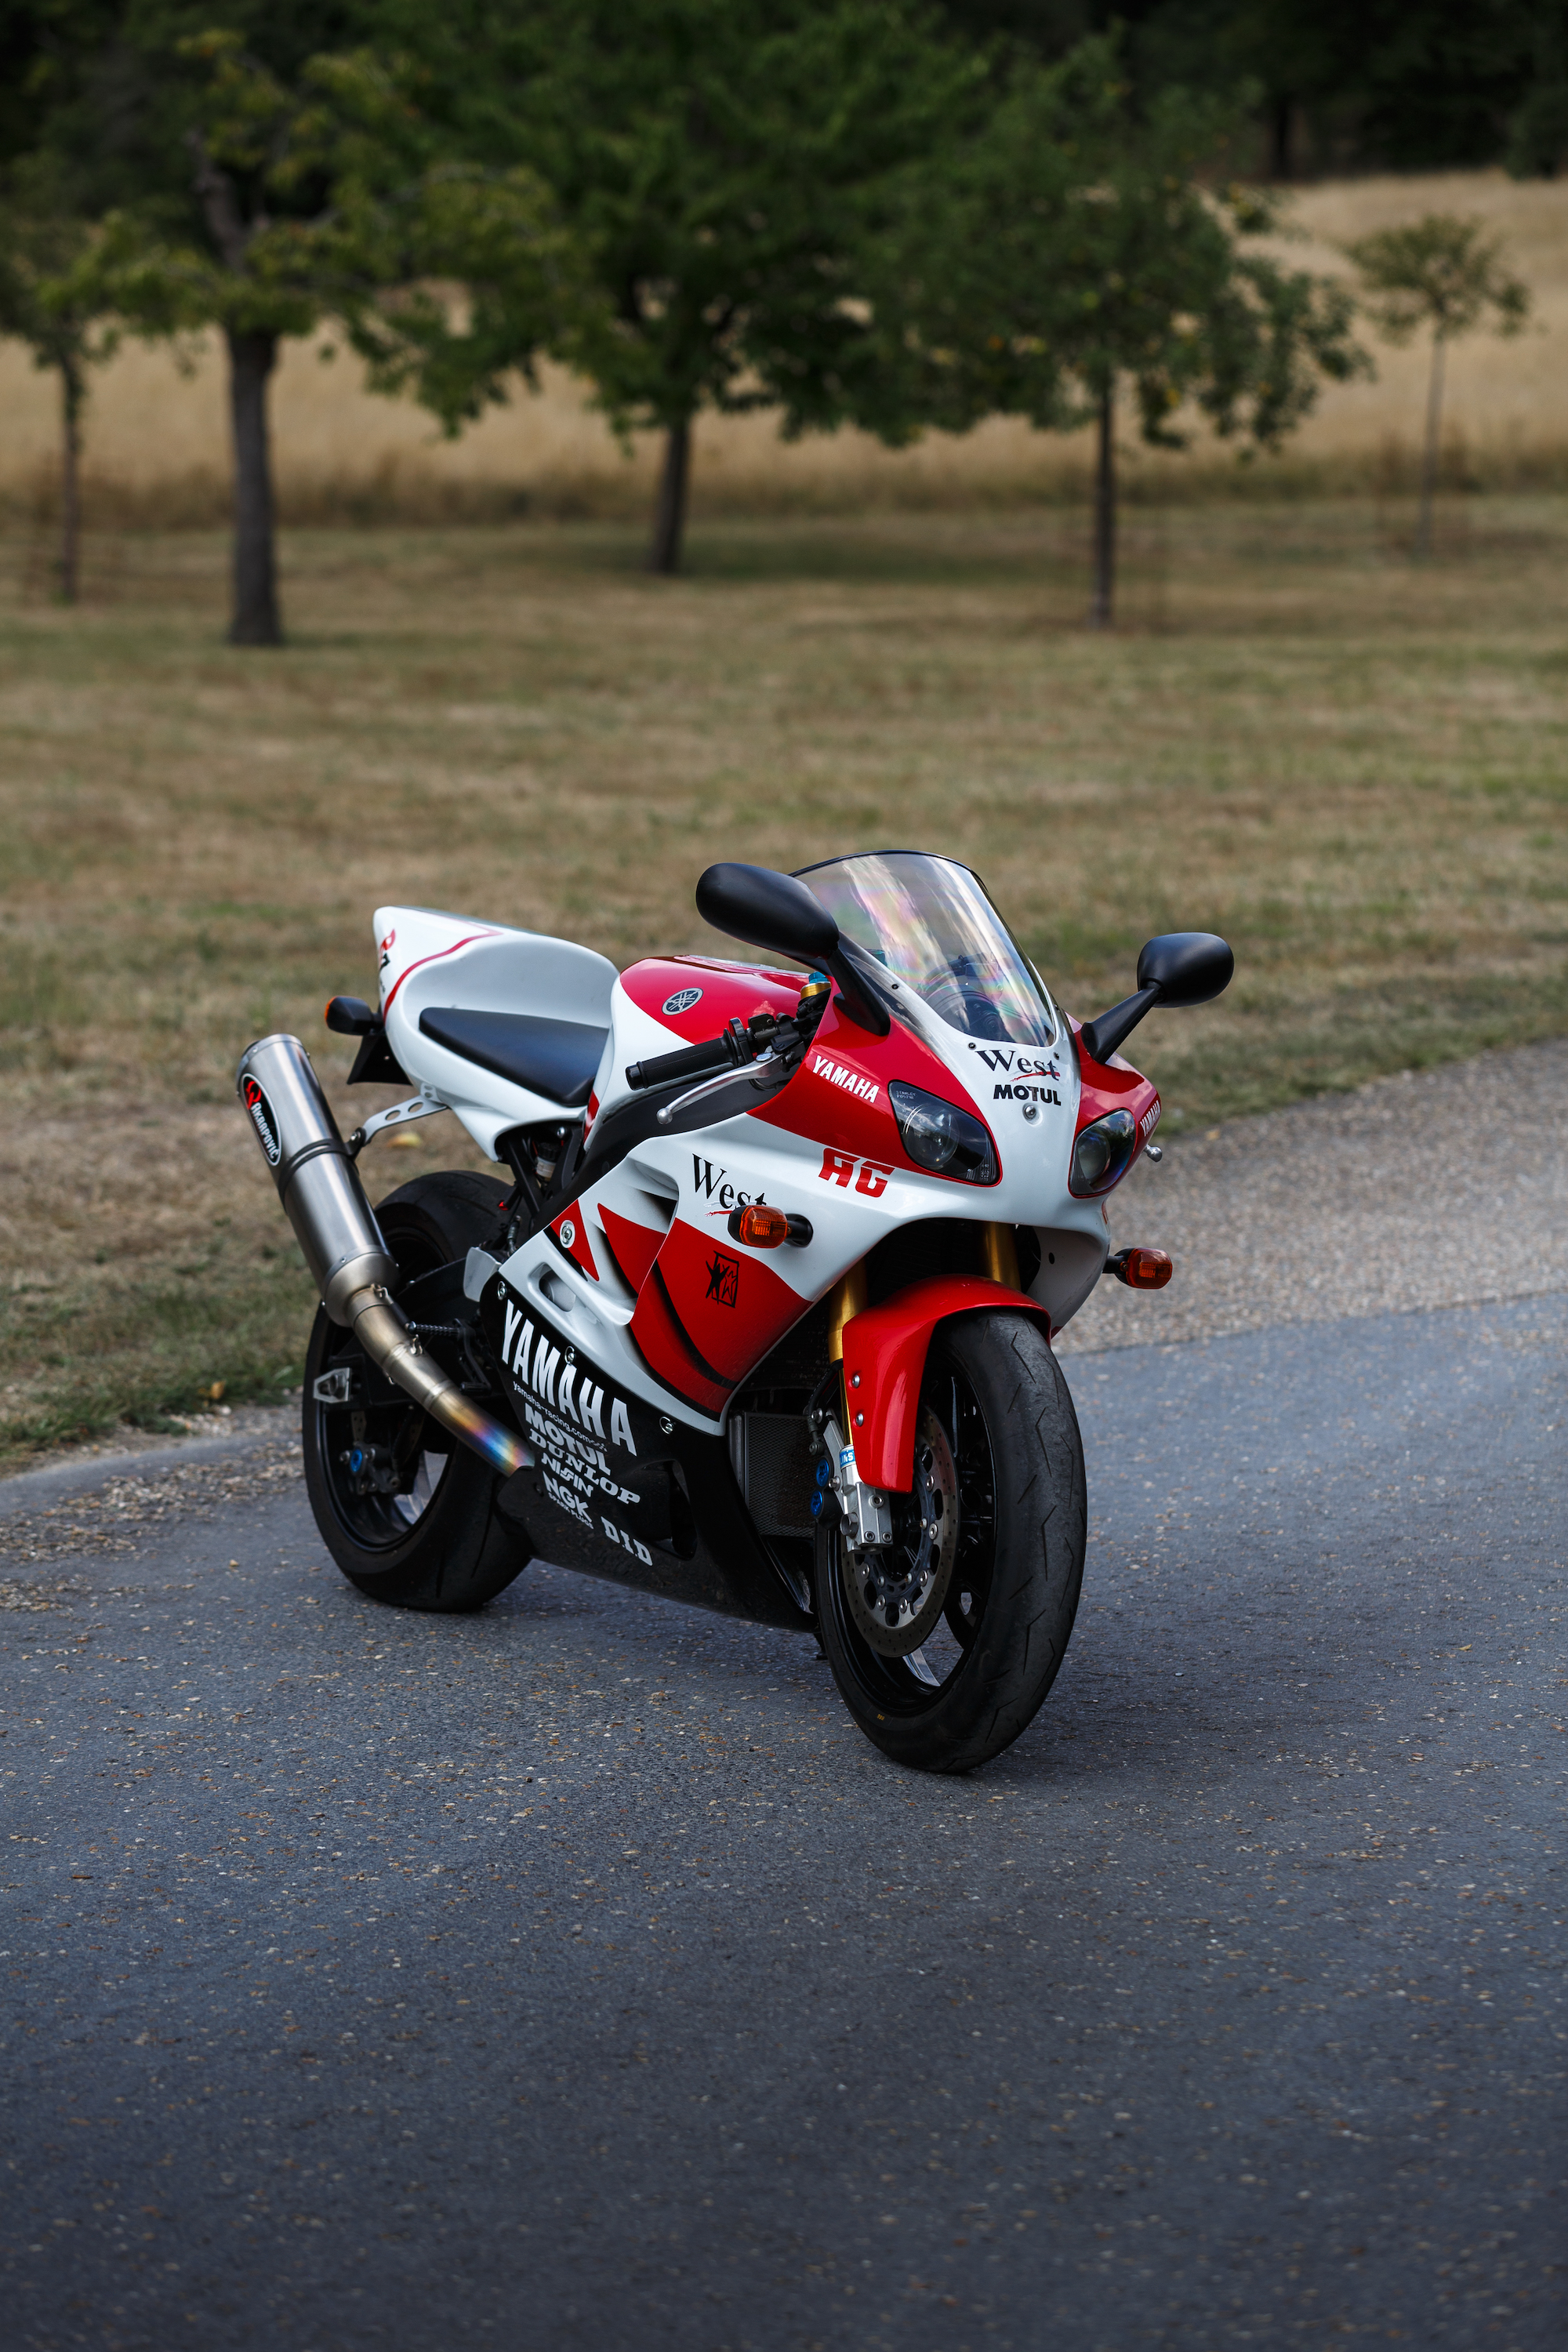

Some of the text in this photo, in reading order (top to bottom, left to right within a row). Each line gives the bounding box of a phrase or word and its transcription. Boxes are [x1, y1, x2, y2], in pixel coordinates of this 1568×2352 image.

[812, 1054, 880, 1103] YAMAHA
[975, 1050, 1059, 1081] West
[993, 1084, 1062, 1106] MOTUL
[1140, 1100, 1160, 1137] YAMAHA
[502, 1299, 637, 1457] YAMAHA
[513, 1381, 590, 1443] yamaha-racing.com
[524, 1402, 612, 1476] MOTUL
[528, 1428, 641, 1504] DUNLOP
[543, 1470, 593, 1523] NGK
